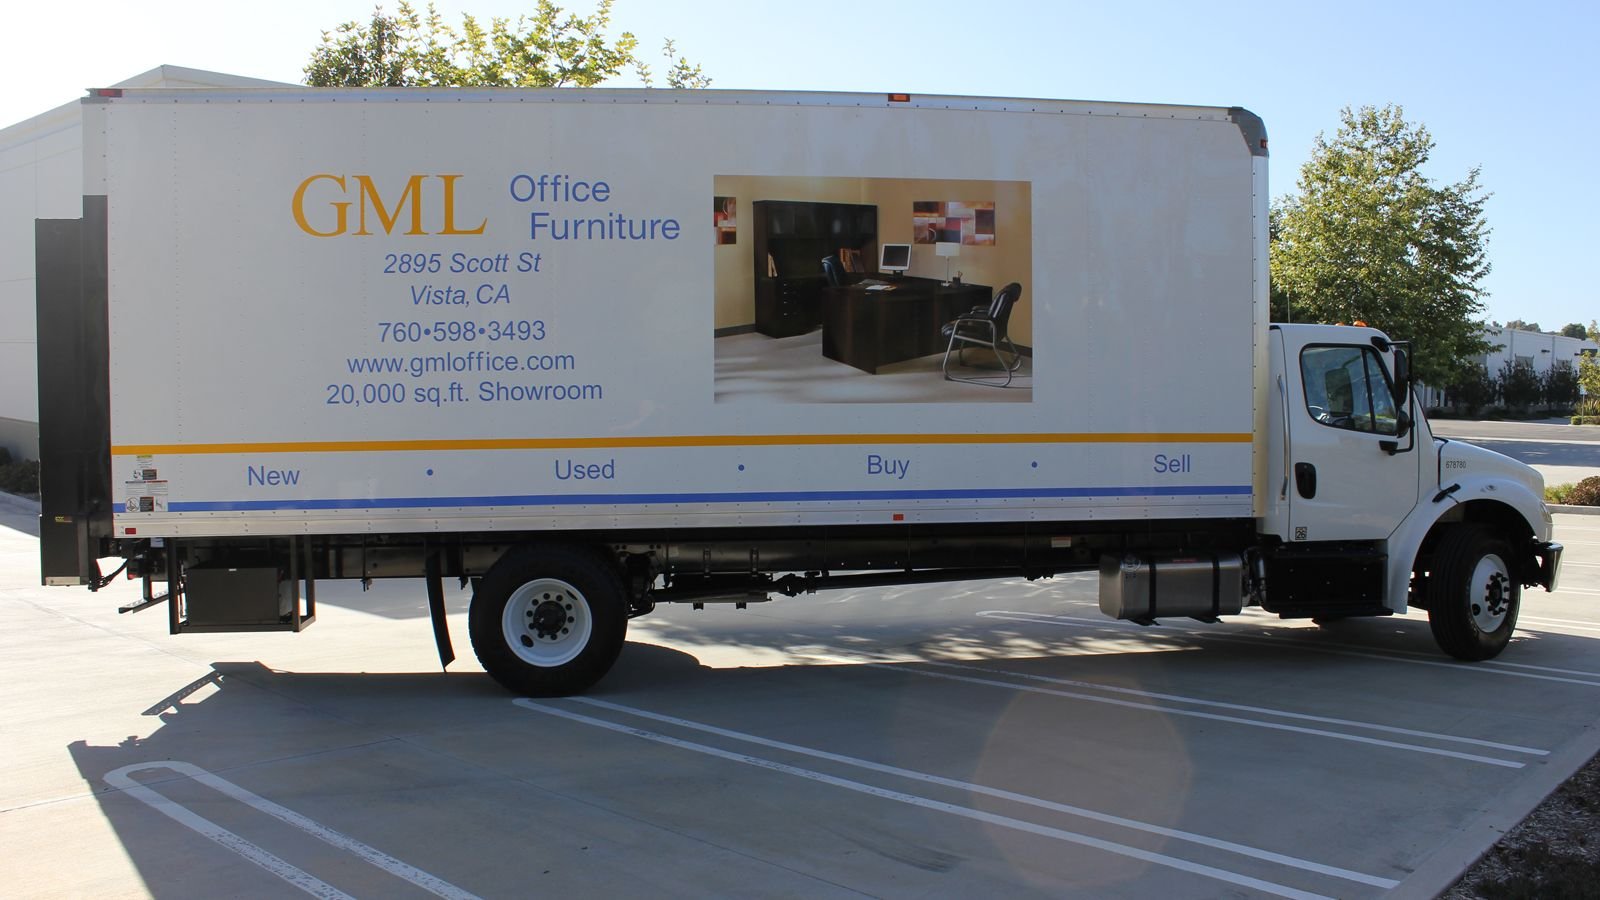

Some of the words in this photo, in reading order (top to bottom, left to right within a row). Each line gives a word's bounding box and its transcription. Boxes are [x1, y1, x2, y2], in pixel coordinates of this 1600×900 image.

[510, 174, 611, 203] Office
[291, 173, 488, 238] GML
[530, 212, 681, 241] Furniture
[383, 253, 442, 274] 2895
[449, 252, 509, 274] Scott
[516, 251, 542, 273] St
[409, 284, 471, 308] Vista,
[475, 283, 511, 305] CA
[346, 350, 576, 377] www.gmloffice.com
[326, 383, 406, 407] 20,000
[413, 383, 471, 407] sq.ft.
[478, 381, 604, 402] Showroom
[247, 466, 300, 486] New
[554, 460, 615, 481] Used
[867, 454, 911, 481] Buy
[1154, 455, 1192, 474] Sell
